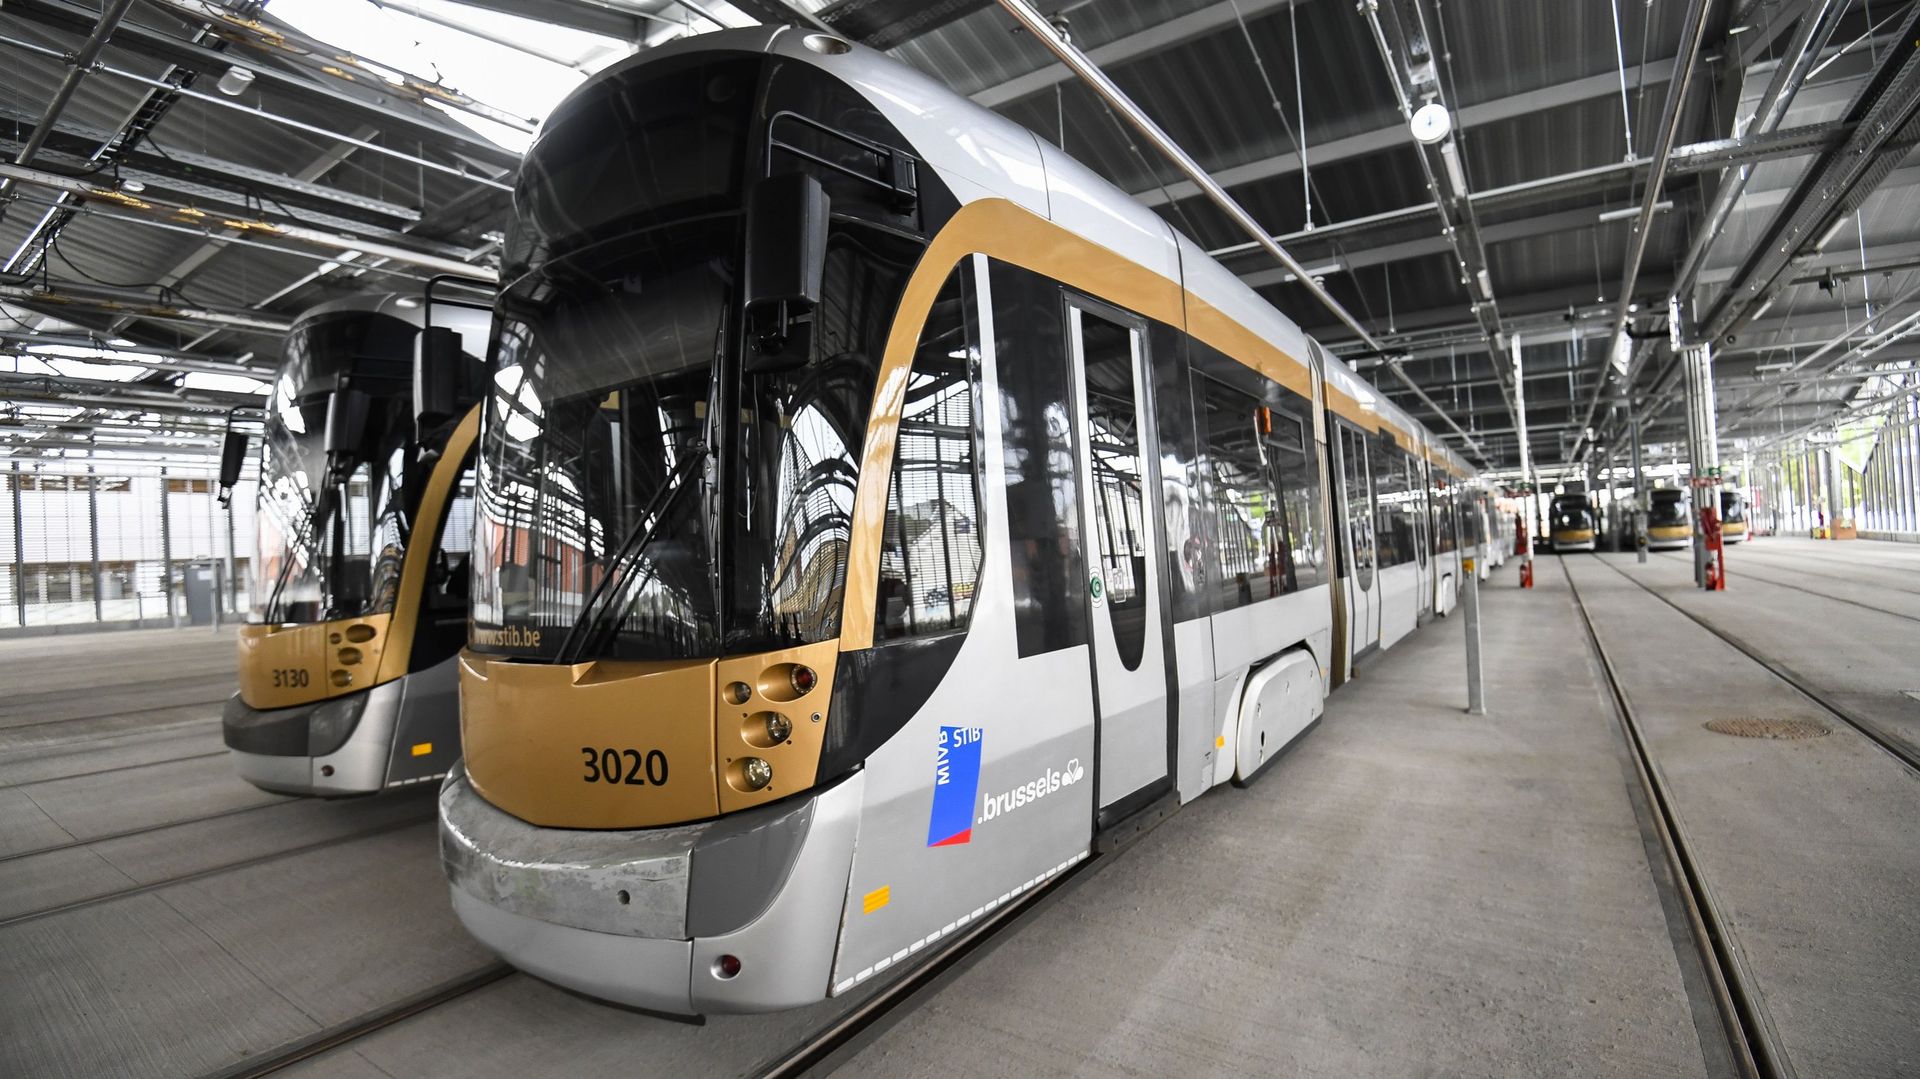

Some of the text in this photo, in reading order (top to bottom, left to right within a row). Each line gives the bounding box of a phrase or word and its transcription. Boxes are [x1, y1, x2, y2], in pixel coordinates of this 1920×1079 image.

[272, 669, 309, 688] 3130
[953, 727, 981, 748] STIB
[581, 747, 669, 787] 3020
[937, 730, 950, 785] MIVB
